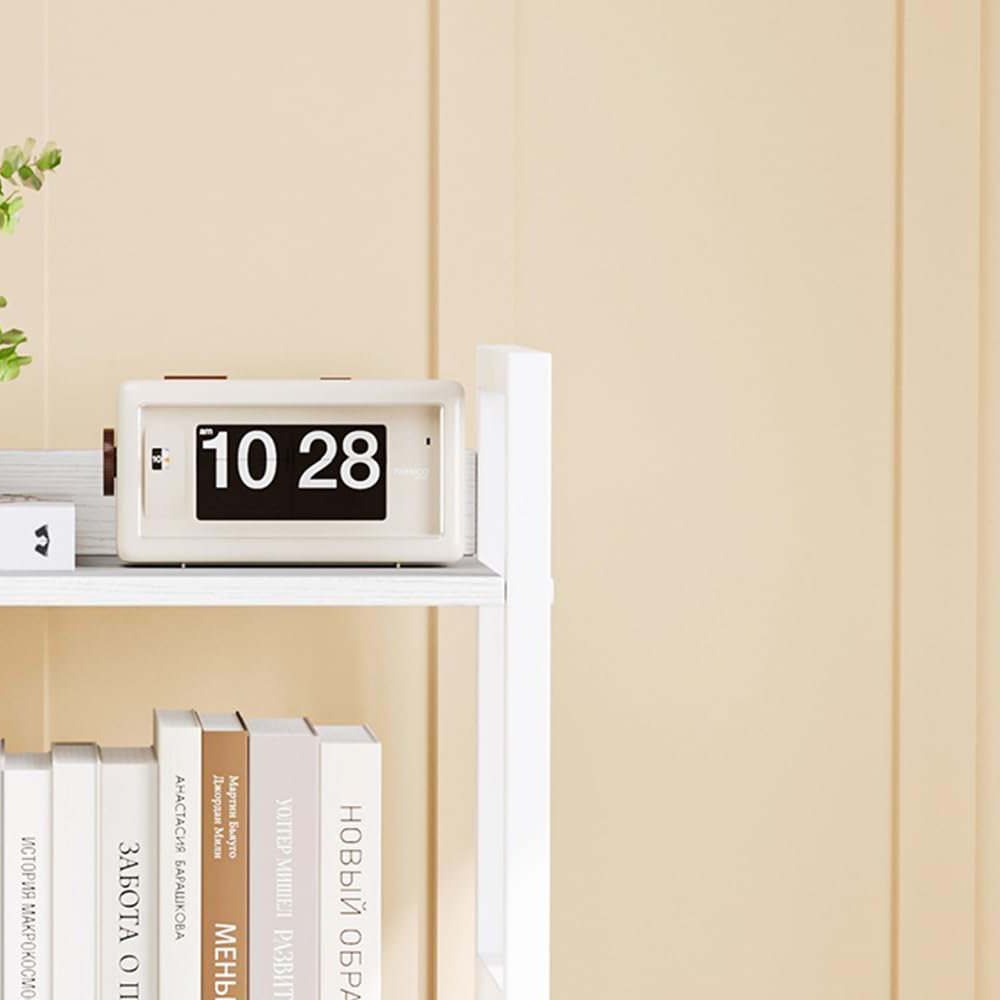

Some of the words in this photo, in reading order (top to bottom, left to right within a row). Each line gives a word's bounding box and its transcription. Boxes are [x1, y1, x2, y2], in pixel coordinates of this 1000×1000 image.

[202, 430, 277, 489] 10
[298, 430, 381, 489] 28
[175, 776, 187, 853] АНАСТАСИЯ
[275, 798, 293, 856] УОЛТЕР
[21, 836, 37, 900] ИСТОРИЯ
[275, 858, 294, 919] МИШЕЛ
[339, 805, 367, 916] НОВЫЙ
[118, 843, 140, 943] ЗАБОТА
[175, 859, 187, 940] БАРАШКОВА
[119, 954, 140, 973] О
